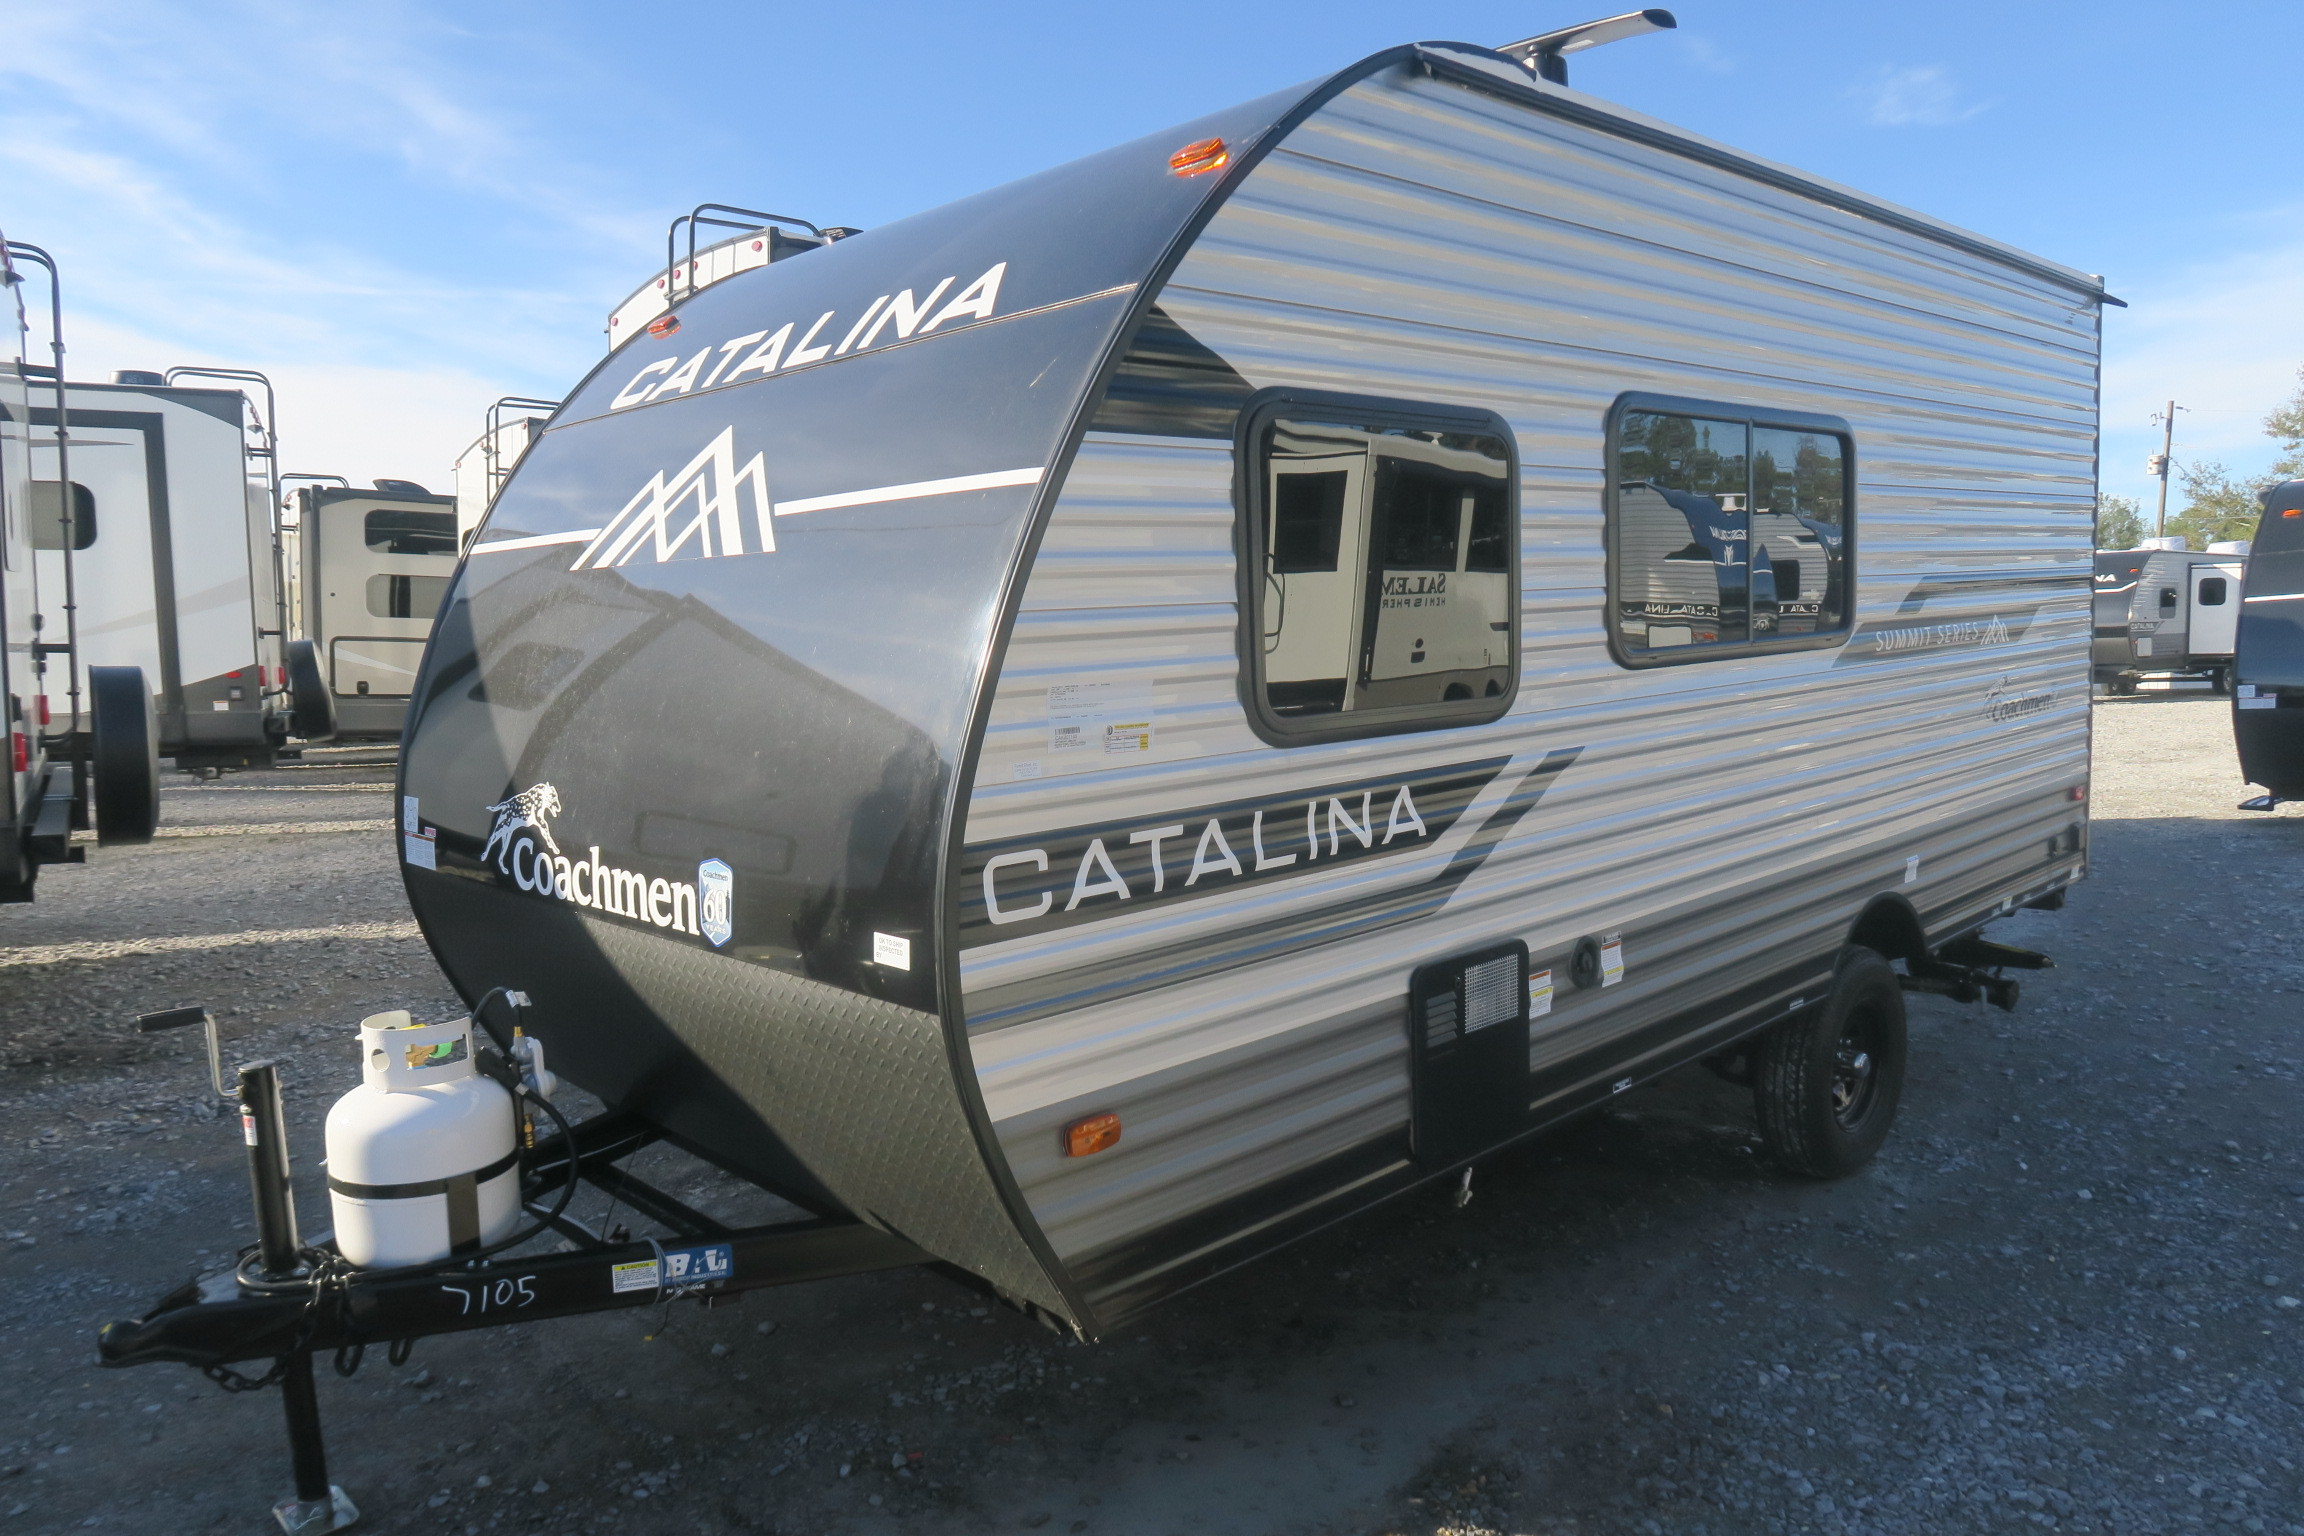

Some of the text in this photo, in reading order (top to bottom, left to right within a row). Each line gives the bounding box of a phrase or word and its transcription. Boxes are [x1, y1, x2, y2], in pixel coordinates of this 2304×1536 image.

[610, 261, 1007, 410] CATALINA
[1876, 621, 1980, 651] SUMMIT SERIES
[982, 784, 1428, 926] CATALINA
[513, 837, 700, 936] Coachmen
[702, 869, 729, 882] Coachmen
[703, 889, 727, 926] 60
[441, 1275, 537, 1315] 7105
